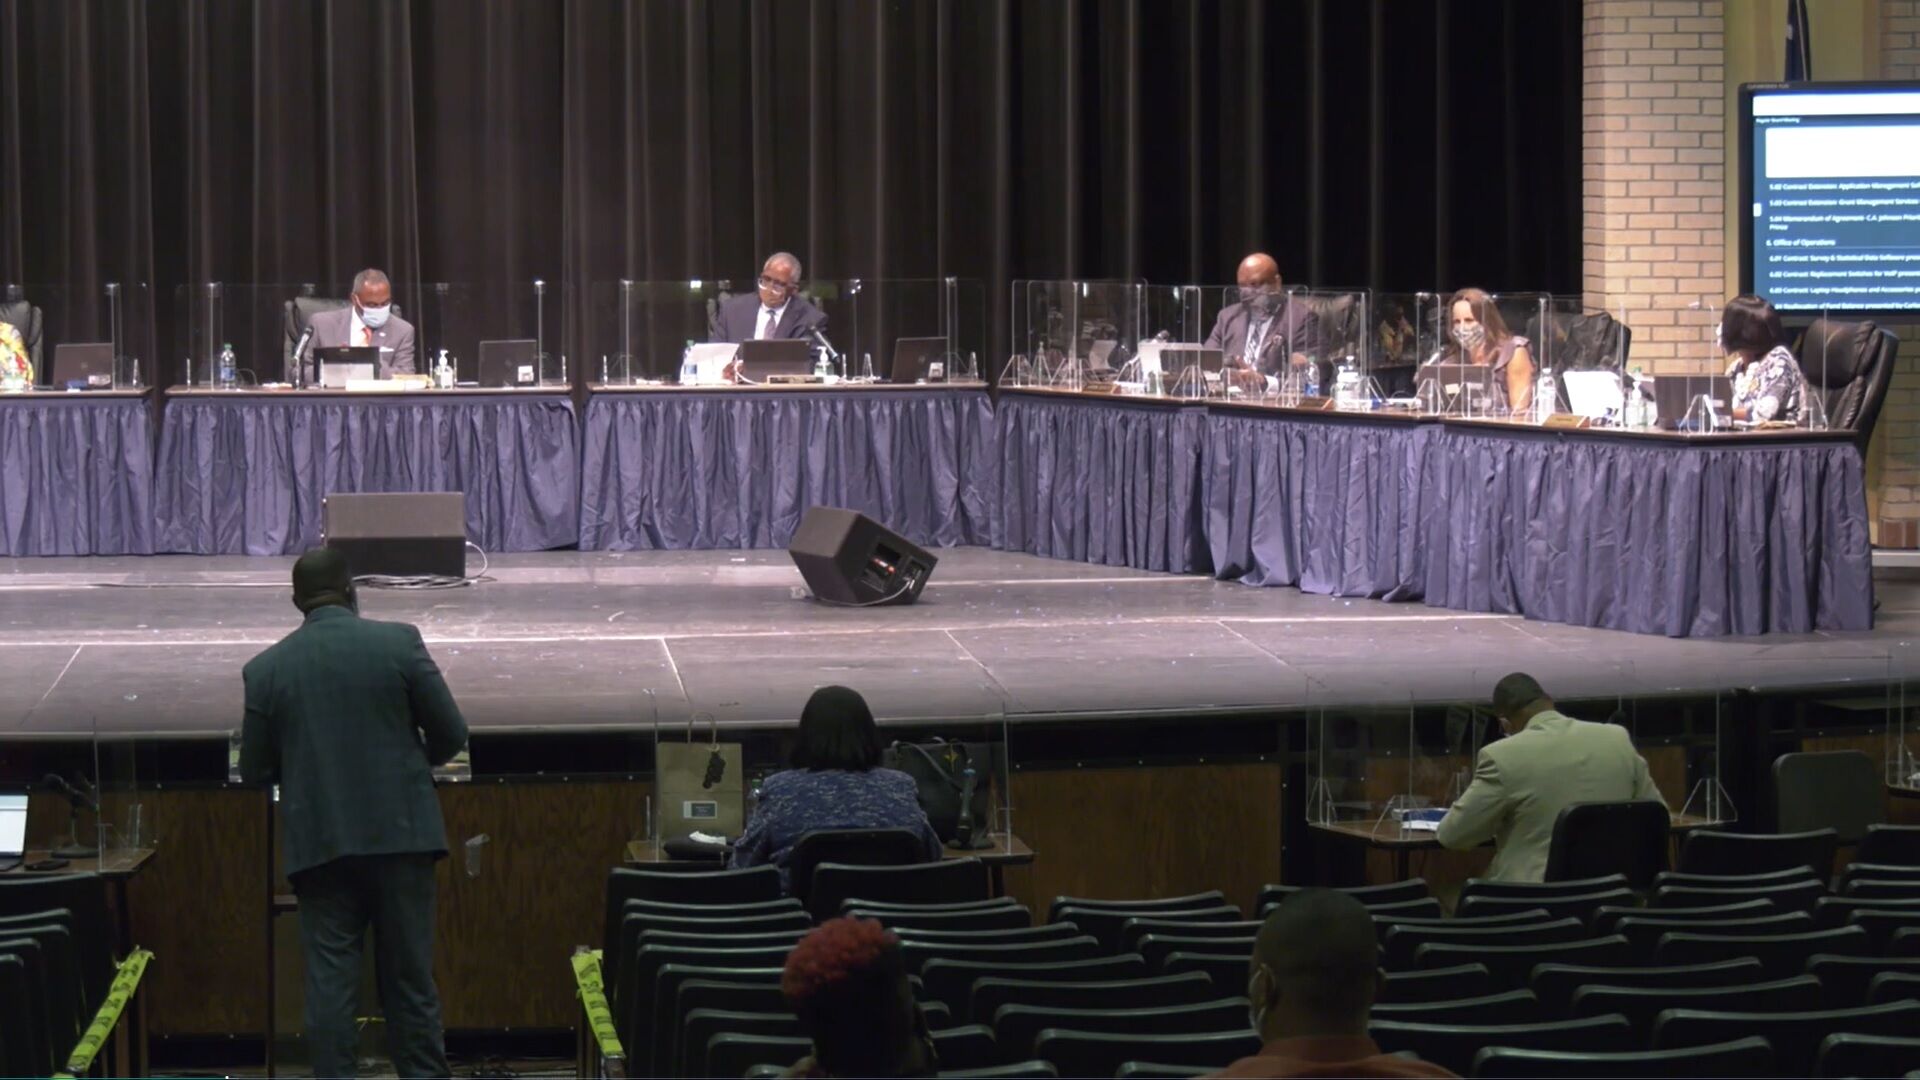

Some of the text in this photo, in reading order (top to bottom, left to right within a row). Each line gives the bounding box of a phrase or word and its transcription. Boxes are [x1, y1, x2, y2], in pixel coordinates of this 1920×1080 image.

[1838, 183, 1870, 191] Application
[1870, 182, 1909, 191] Management
[1855, 198, 1894, 207] Management
[1824, 214, 1832, 222] of
[1878, 214, 1902, 222] Johnson
[1800, 239, 1836, 248] Operations
[1810, 255, 1829, 263] Survey
[1810, 271, 1847, 279] Replacement
[1830, 287, 1868, 295] Headphones
[1818, 302, 1826, 310] of
[1841, 302, 1865, 310] Balance
